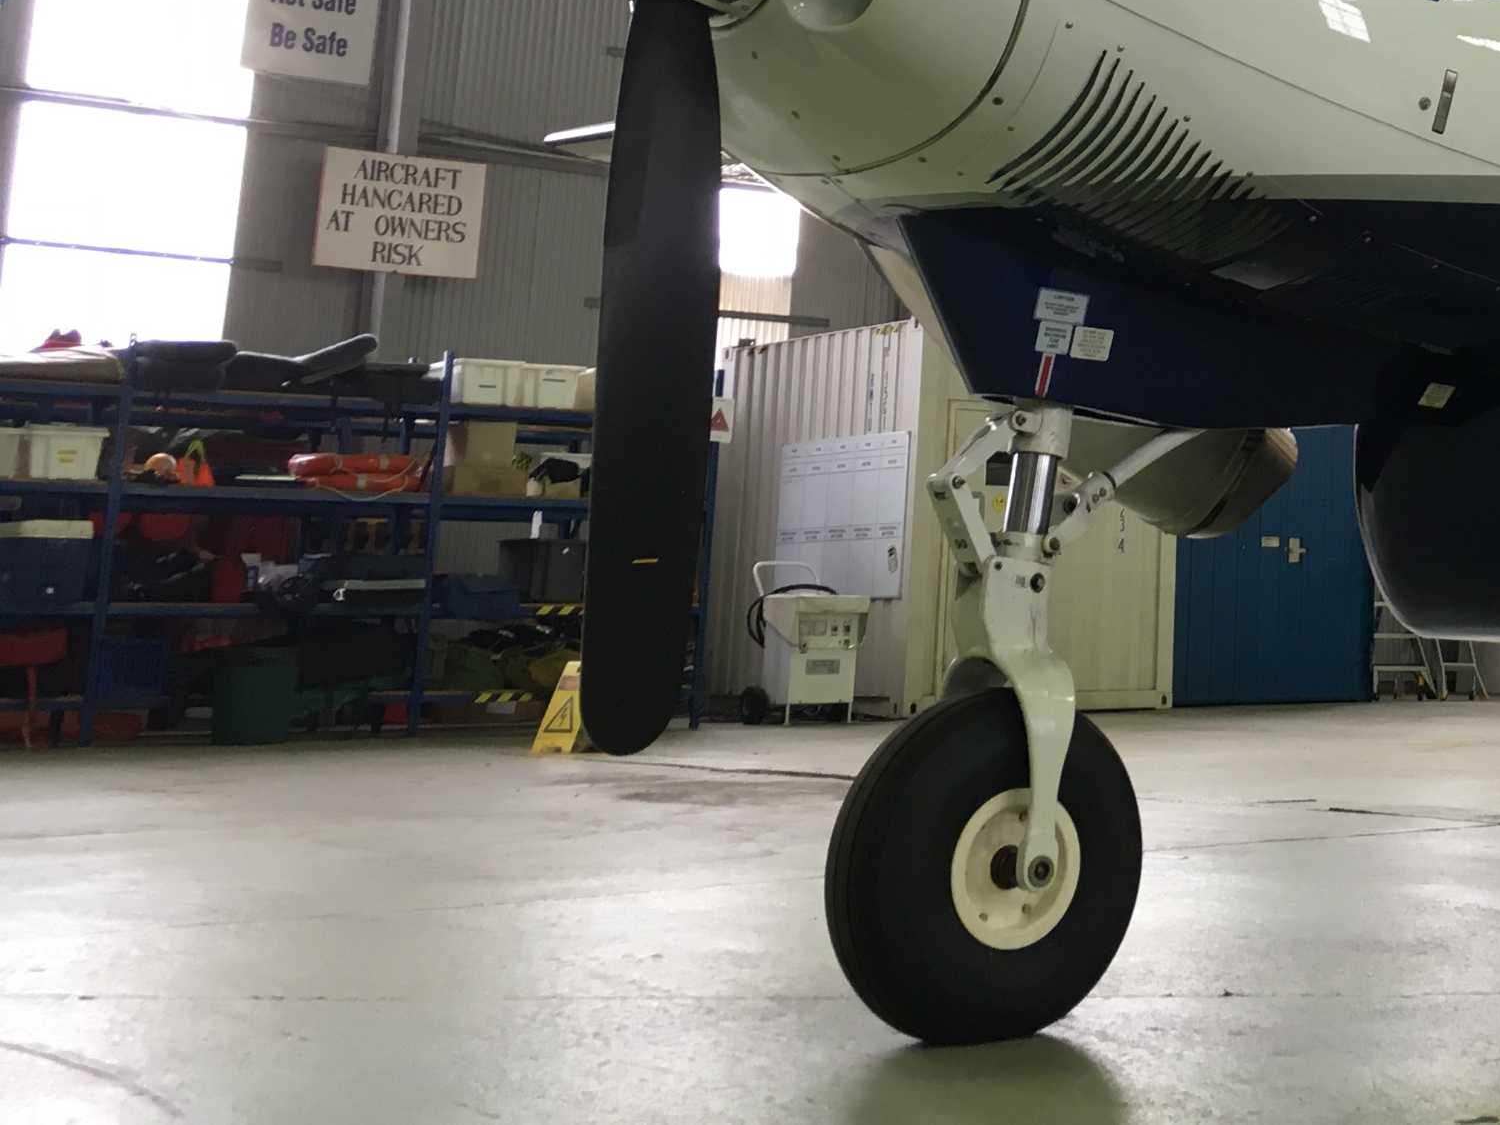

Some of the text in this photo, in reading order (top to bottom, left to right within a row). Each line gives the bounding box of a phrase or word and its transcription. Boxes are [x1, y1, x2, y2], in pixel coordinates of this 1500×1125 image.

[270, 22, 348, 57] Be Safe
[354, 158, 462, 190] AIRCRAFT
[326, 209, 467, 243] AT OWNERS
[371, 241, 424, 267] RISK
